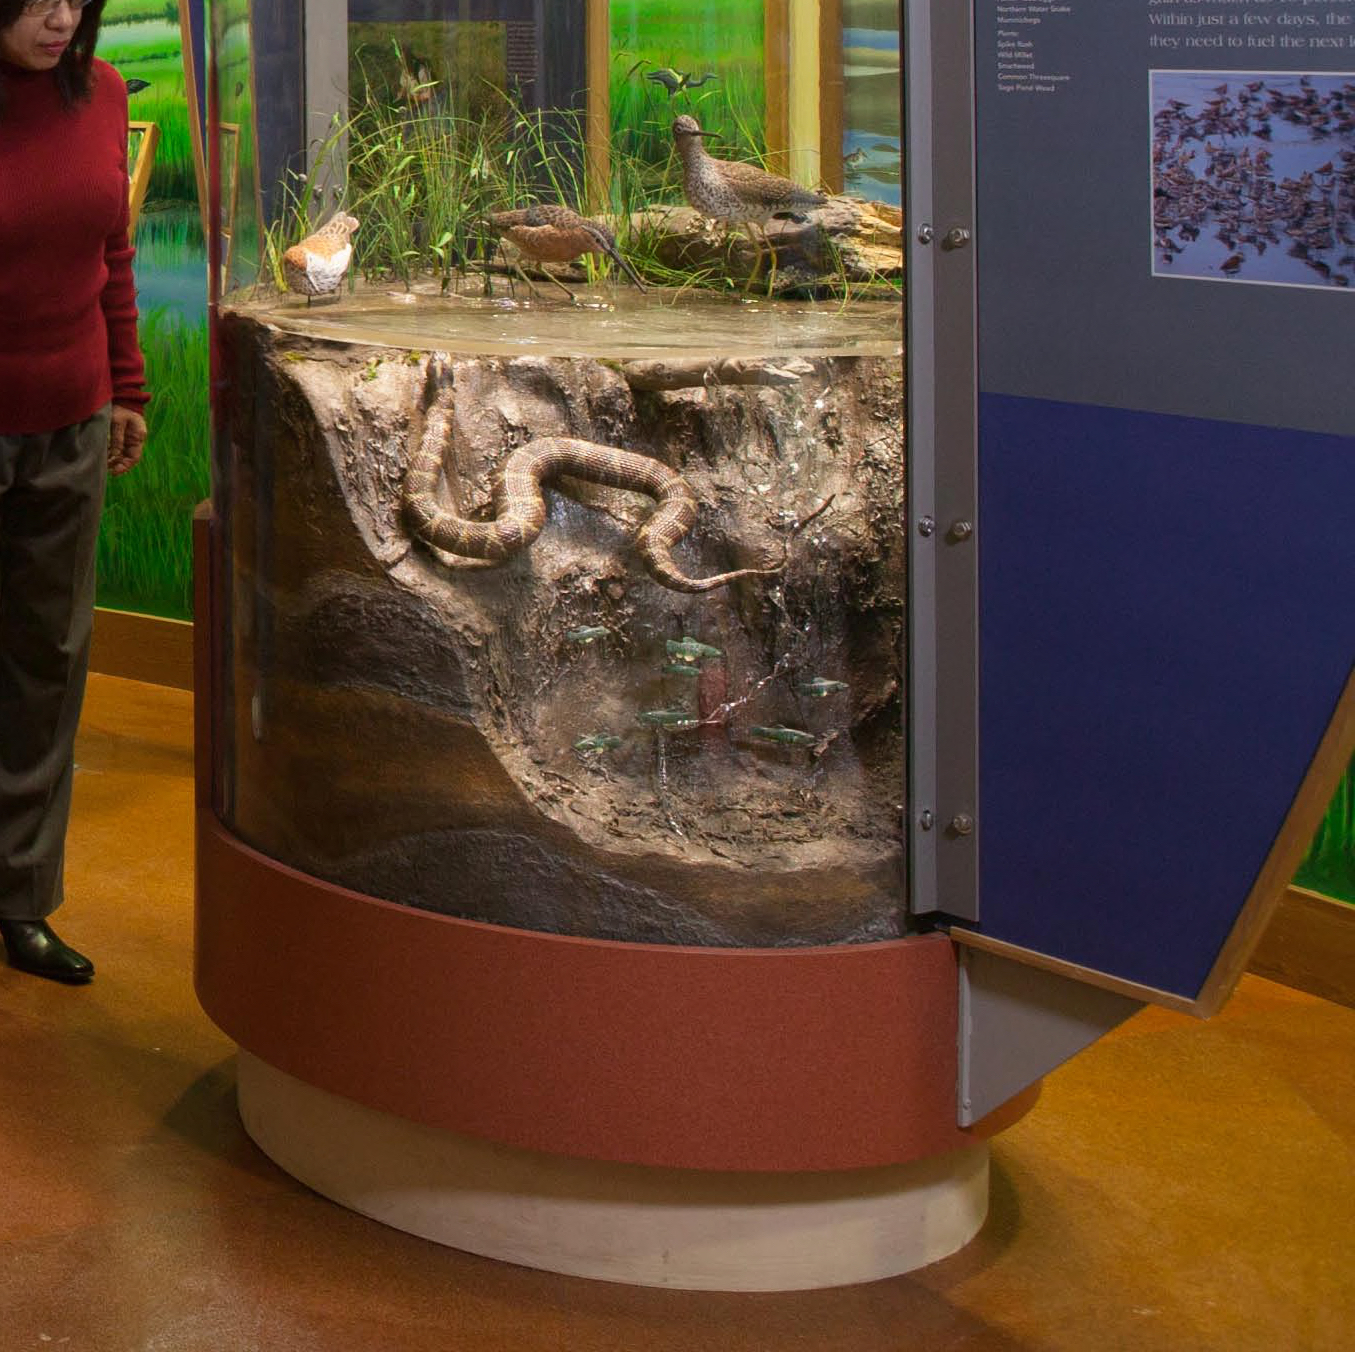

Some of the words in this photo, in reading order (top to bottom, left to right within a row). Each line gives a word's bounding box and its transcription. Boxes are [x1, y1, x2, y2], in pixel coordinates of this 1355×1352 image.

[1148, 13, 1193, 25] Within
[1196, 13, 1224, 28] just
[1242, 13, 1271, 24] few
[1326, 12, 1350, 24] the
[1149, 35, 1179, 50] they
[1185, 35, 1223, 47] need
[1227, 35, 1242, 47] to
[1247, 35, 1275, 47] fuel
[1279, 35, 1306, 47] the
[1309, 35, 1343, 47] next
